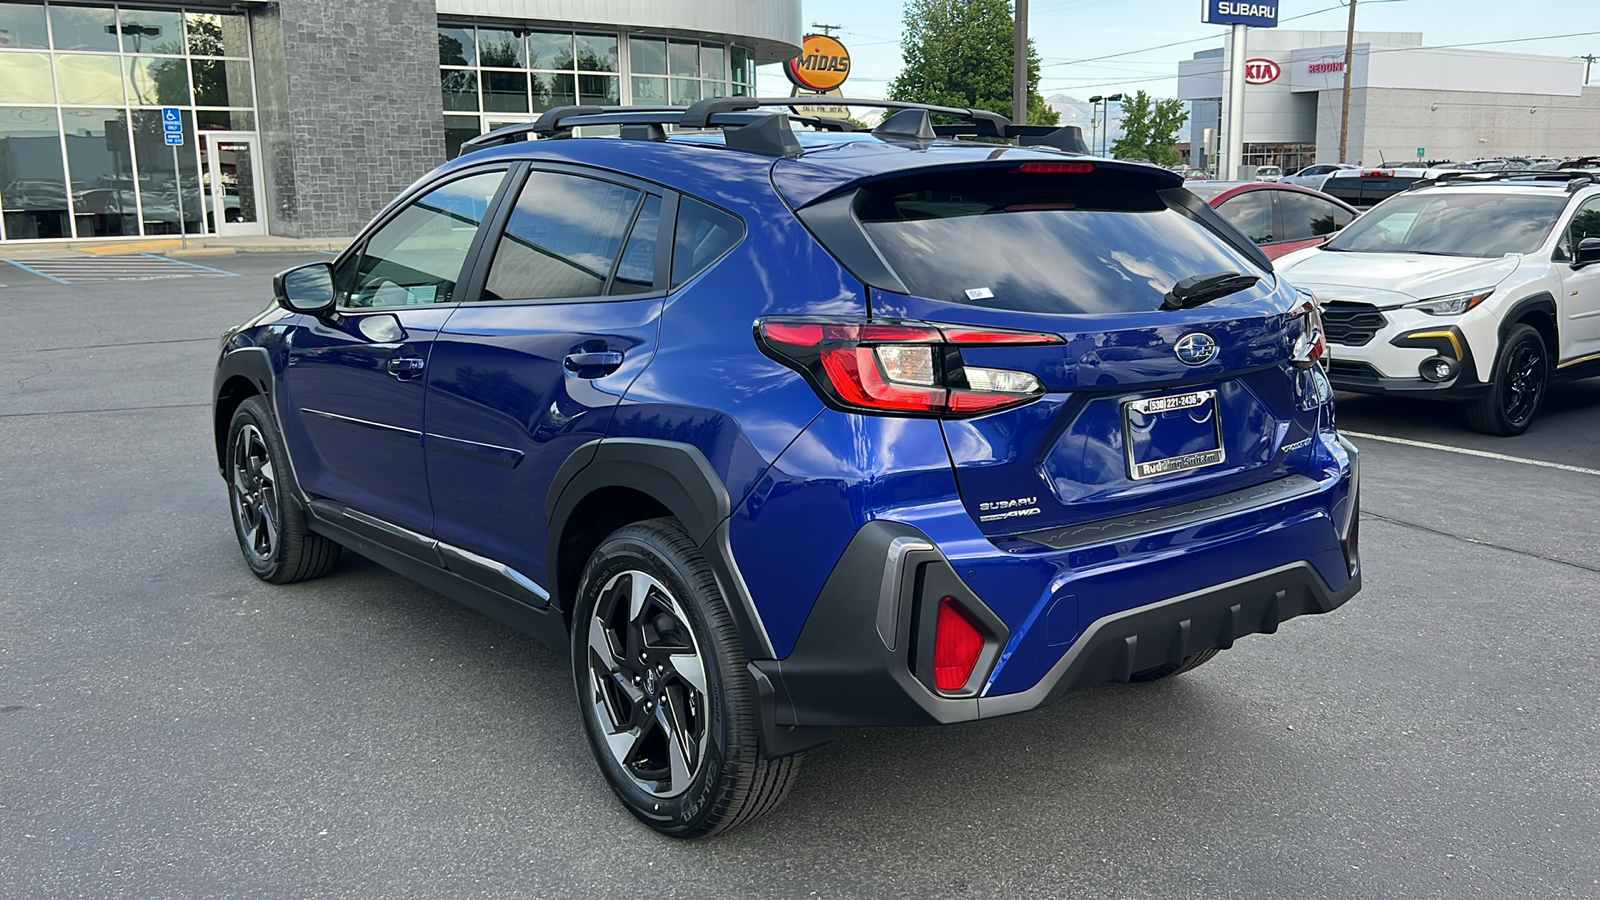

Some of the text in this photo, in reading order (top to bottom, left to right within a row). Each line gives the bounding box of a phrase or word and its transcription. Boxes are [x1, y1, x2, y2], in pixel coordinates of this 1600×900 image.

[1218, 2, 1275, 18] SUBARU
[797, 54, 848, 72] MIDAS
[1308, 62, 1345, 73] REDDIN
[1245, 64, 1274, 79] KIA
[1149, 398, 1167, 411] (530)
[980, 497, 1037, 510] SUBARU
[1004, 508, 1041, 519] AWD
